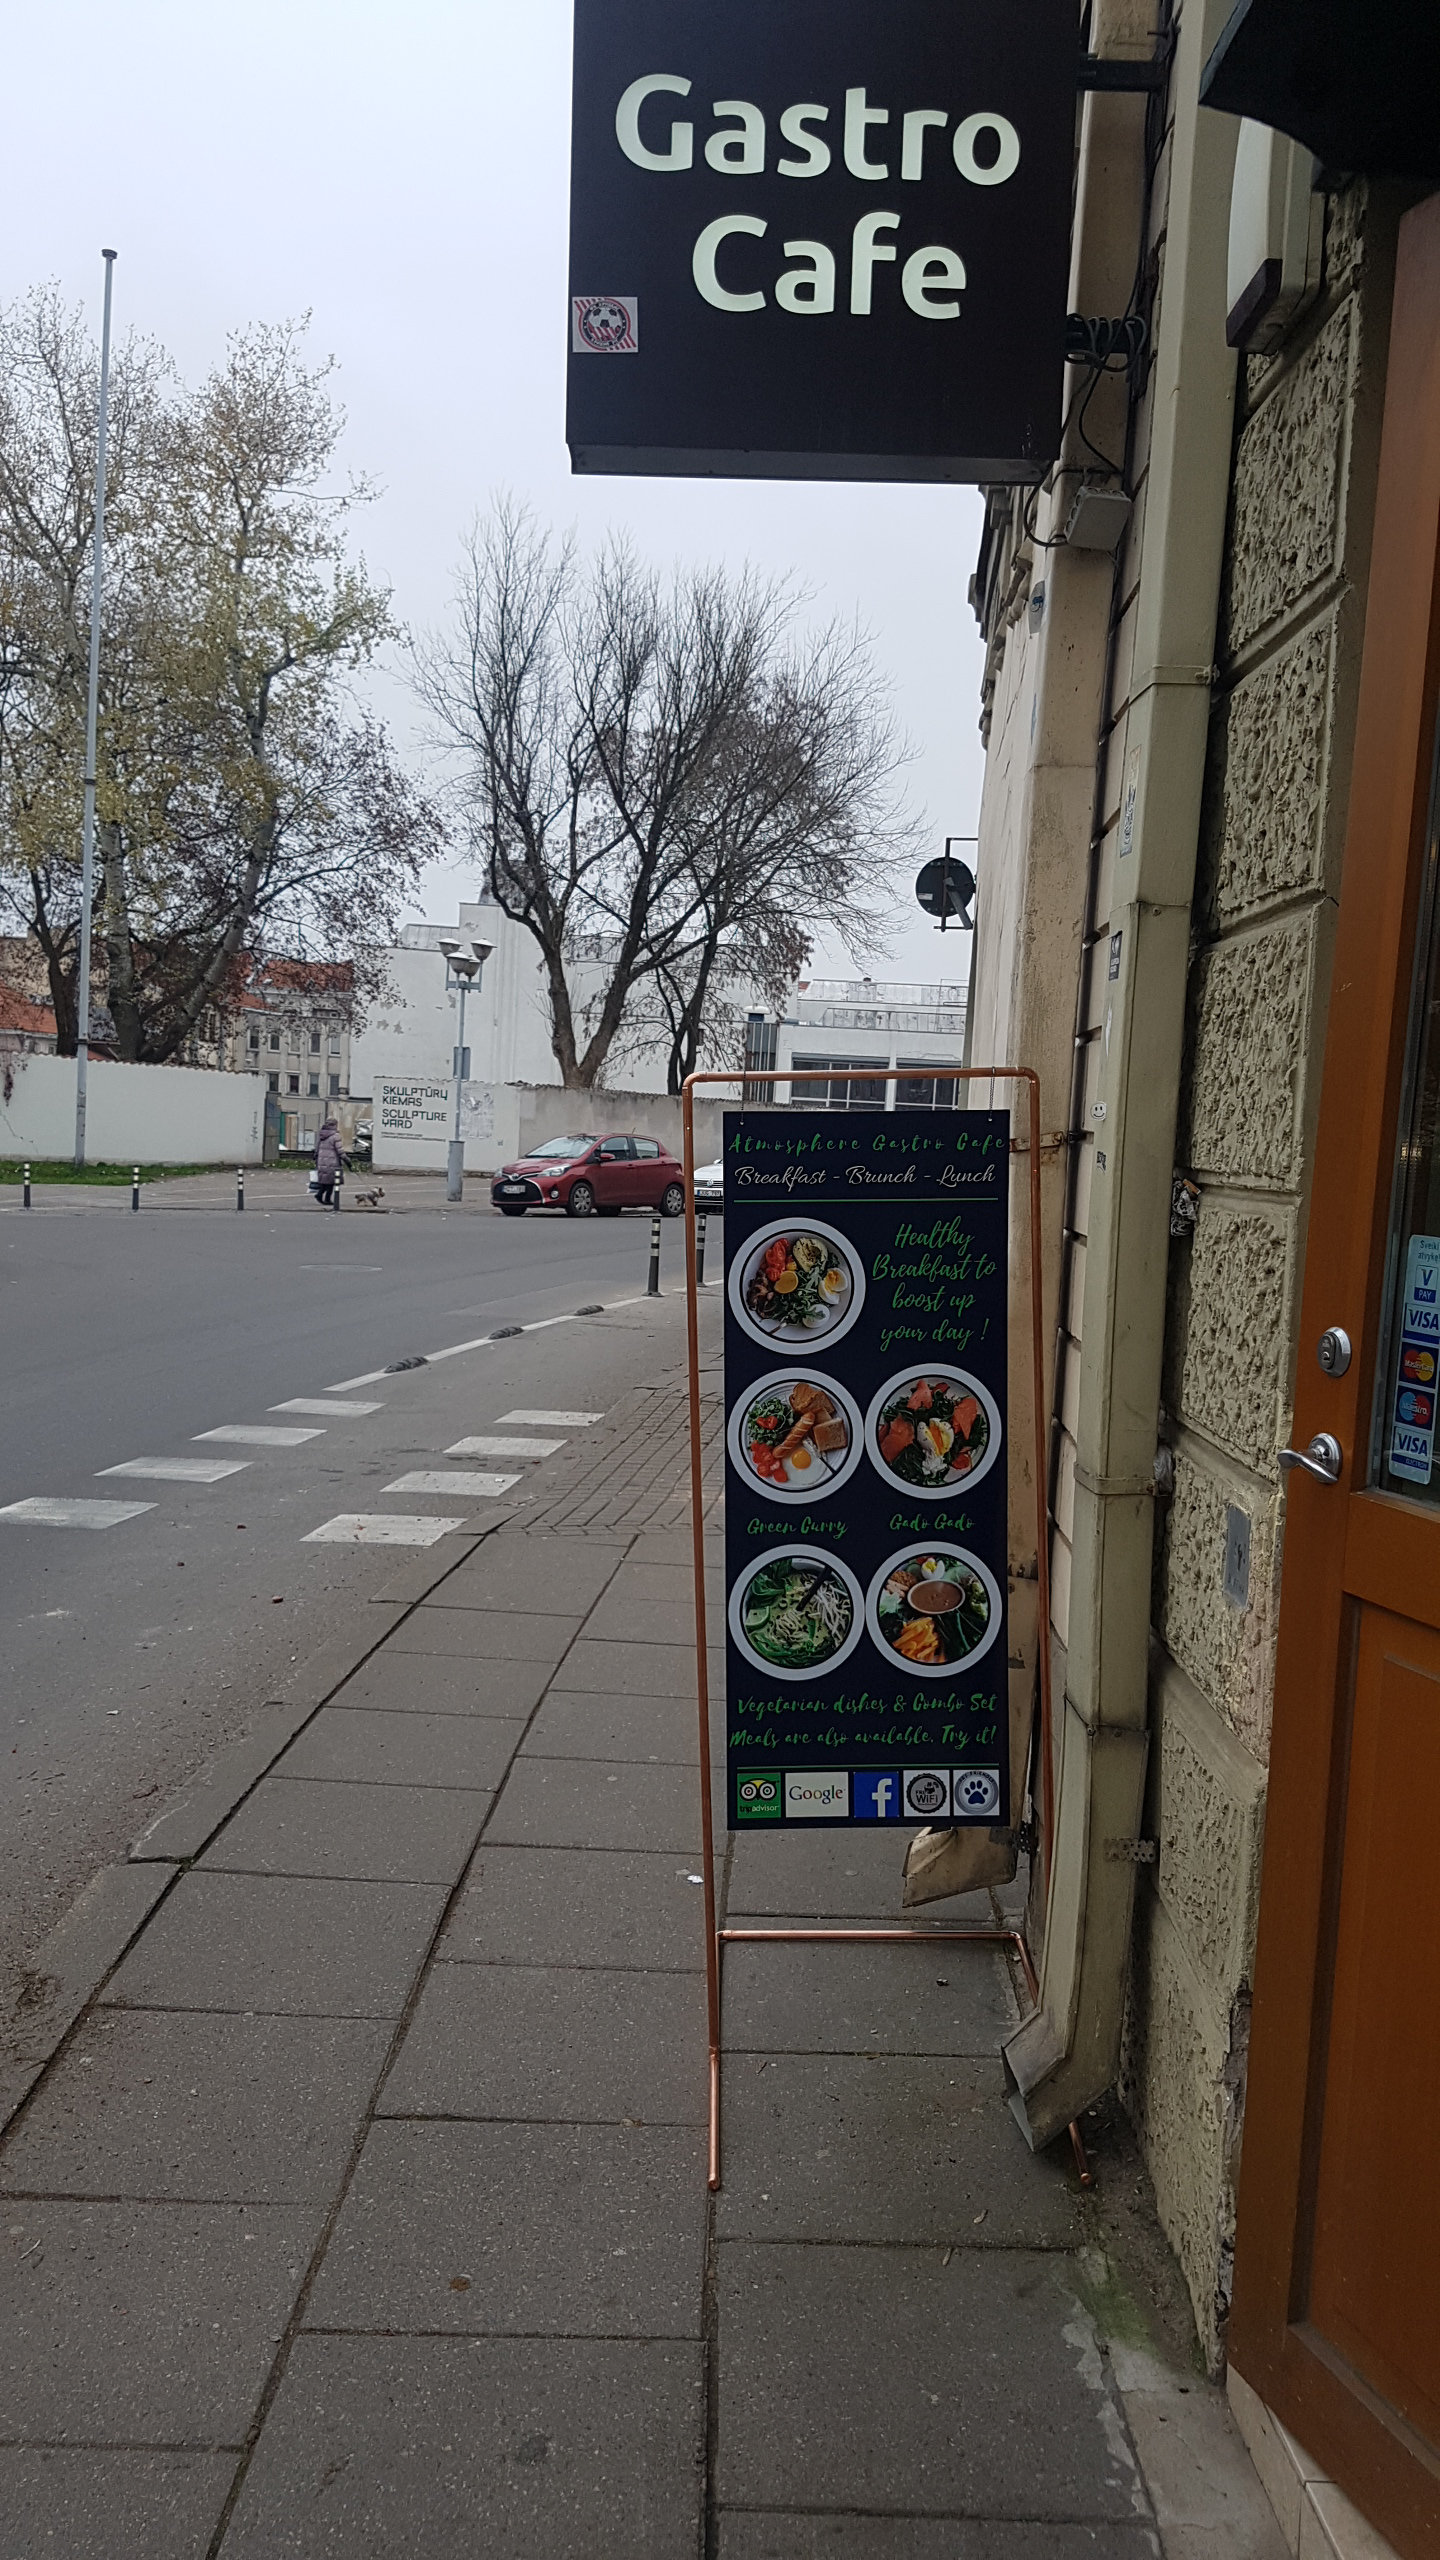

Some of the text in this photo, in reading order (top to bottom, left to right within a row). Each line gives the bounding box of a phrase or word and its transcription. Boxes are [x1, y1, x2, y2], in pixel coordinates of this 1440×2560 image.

[616, 74, 1020, 185] Gastro
[692, 211, 966, 319] Cafe
[382, 1096, 422, 1107] KIEMAS
[383, 1086, 448, 1100] SKULPTŪRŲ
[382, 1109, 447, 1122] SCULPTURE
[382, 1119, 412, 1129] YARD
[728, 1132, 1006, 1157] Atmosphere Gastro Cafe
[735, 1165, 827, 1192] Breakfast
[845, 1164, 917, 1185] Brunch
[936, 1163, 996, 1188] Lunch
[894, 1215, 975, 1256] Healthy
[872, 1253, 998, 1282] Breakfast to
[1421, 1268, 1434, 1286] V
[892, 1281, 977, 1317] boost up
[1418, 1290, 1432, 1300] PAY
[1408, 1308, 1440, 1331] VISA
[880, 1325, 928, 1351] your
[932, 1318, 975, 1351] day
[1398, 1431, 1428, 1457] VISA
[747, 1515, 848, 1540] Green Curry
[889, 1512, 977, 1531] Gado Gado
[738, 1692, 998, 1721] Vegetarian dishes & Combo Set
[729, 1727, 780, 1748] Meals
[785, 1732, 812, 1744] are
[817, 1726, 849, 1747] also
[855, 1725, 934, 1745] available.
[941, 1724, 971, 1750] Try
[789, 1785, 844, 1805] Google
[740, 1804, 779, 1815] tripadvisor
